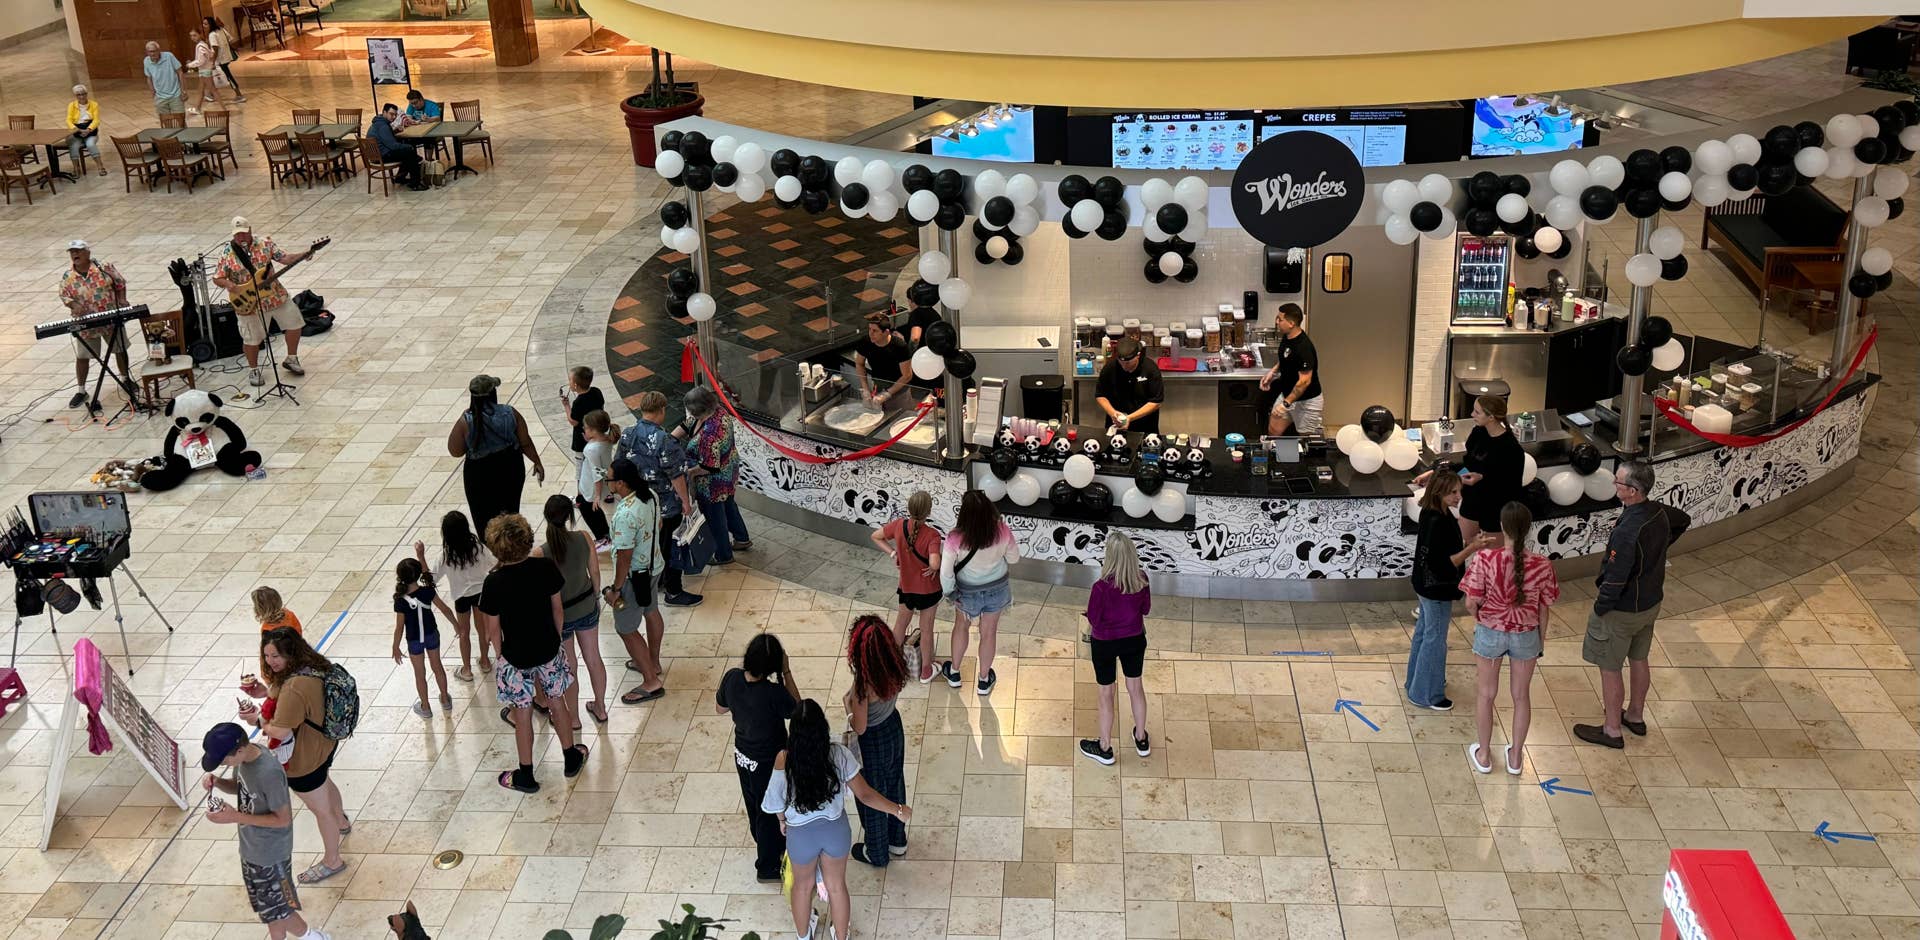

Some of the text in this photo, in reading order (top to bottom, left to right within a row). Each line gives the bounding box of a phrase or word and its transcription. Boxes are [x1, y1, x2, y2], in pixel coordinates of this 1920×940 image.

[1302, 113, 1336, 121] CREPES
[1244, 171, 1347, 215] Wonders
[766, 457, 831, 491] Wonders
[1655, 474, 1722, 509] Wonders
[1185, 523, 1278, 560] Wonders
